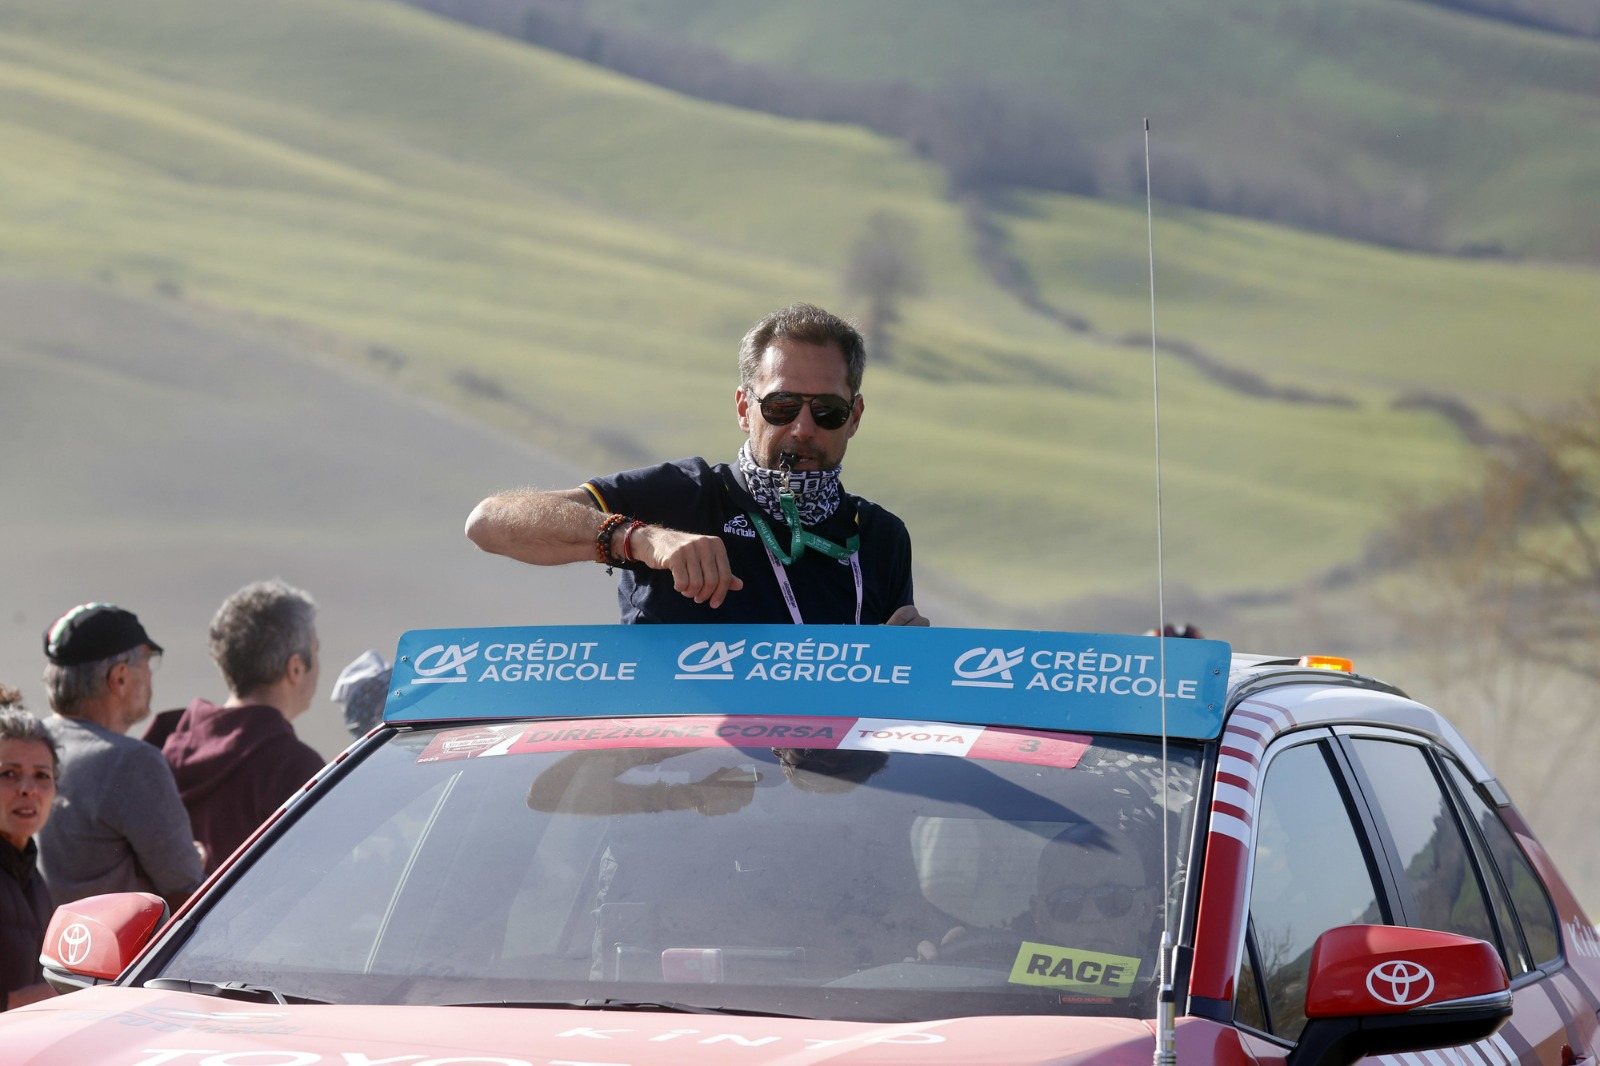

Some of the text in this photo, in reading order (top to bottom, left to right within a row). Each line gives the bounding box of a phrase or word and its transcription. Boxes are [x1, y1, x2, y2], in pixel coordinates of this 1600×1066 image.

[484, 638, 598, 662] CRÉDIT
[751, 637, 870, 662] CRÉDIT
[1030, 648, 1154, 674] CRÉDIT
[478, 662, 637, 682] AGRICOLE
[745, 662, 912, 684] AGRICOLE
[1025, 672, 1198, 699] AGRICOLE
[527, 724, 834, 744] DIREZIONE CORSA
[858, 730, 965, 744] TOYOTA
[1018, 739, 1042, 752] 3
[1026, 953, 1125, 988] RACE
